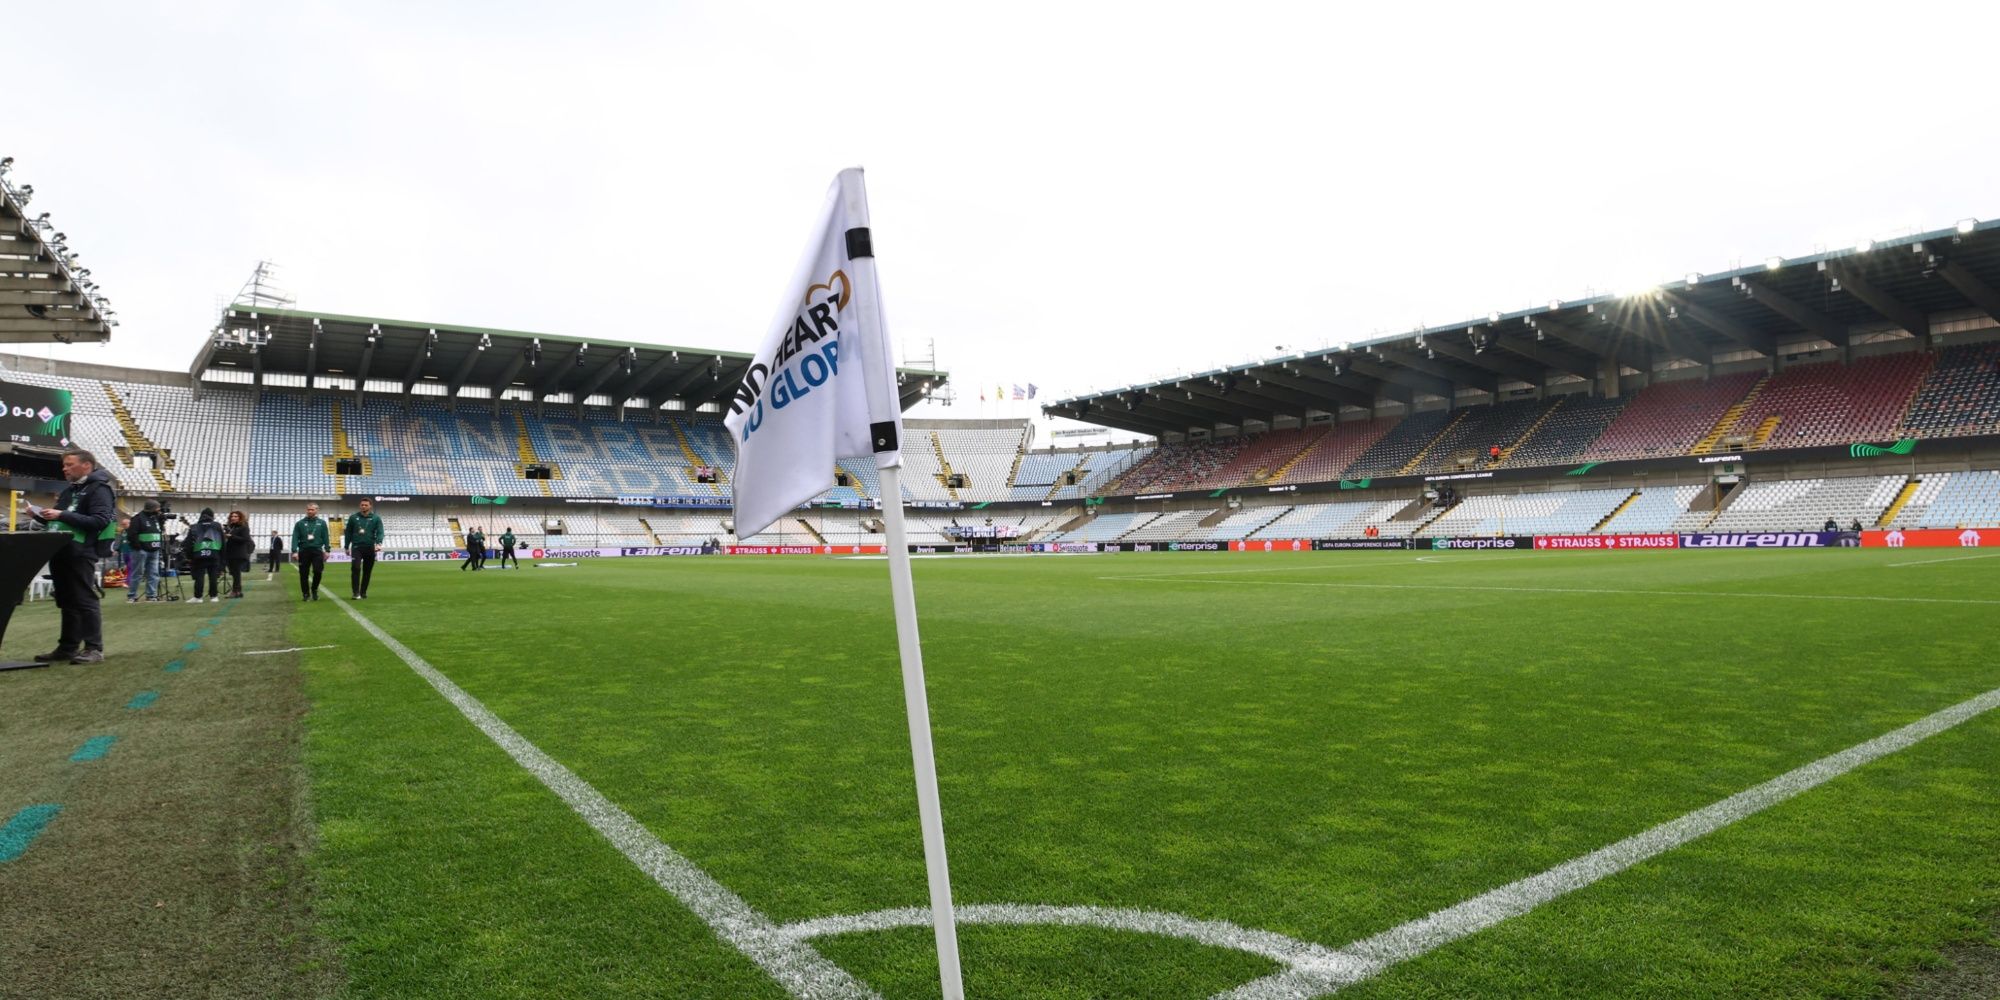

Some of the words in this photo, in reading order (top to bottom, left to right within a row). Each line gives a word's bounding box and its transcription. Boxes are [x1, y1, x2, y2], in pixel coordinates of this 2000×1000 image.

[770, 331, 841, 410] GLOR
[729, 362, 769, 416] NO
[12, 406, 35, 419] 0-0
[667, 497, 680, 505] ARE
[682, 497, 694, 505] THE
[695, 497, 721, 506] FAMOUS
[1171, 541, 1218, 550] enterprise
[1435, 538, 1515, 549] enterprise
[1551, 538, 1601, 547] STRAUSS
[1619, 537, 1674, 547] STRAUSS
[916, 545, 935, 553] bwin
[954, 545, 973, 553] bwin
[1058, 544, 1089, 552] Swissquote
[1103, 543, 1121, 552] bwin
[1134, 543, 1152, 552] bwin
[376, 551, 446, 560] Heineken
[545, 549, 601, 558] Swissquote
